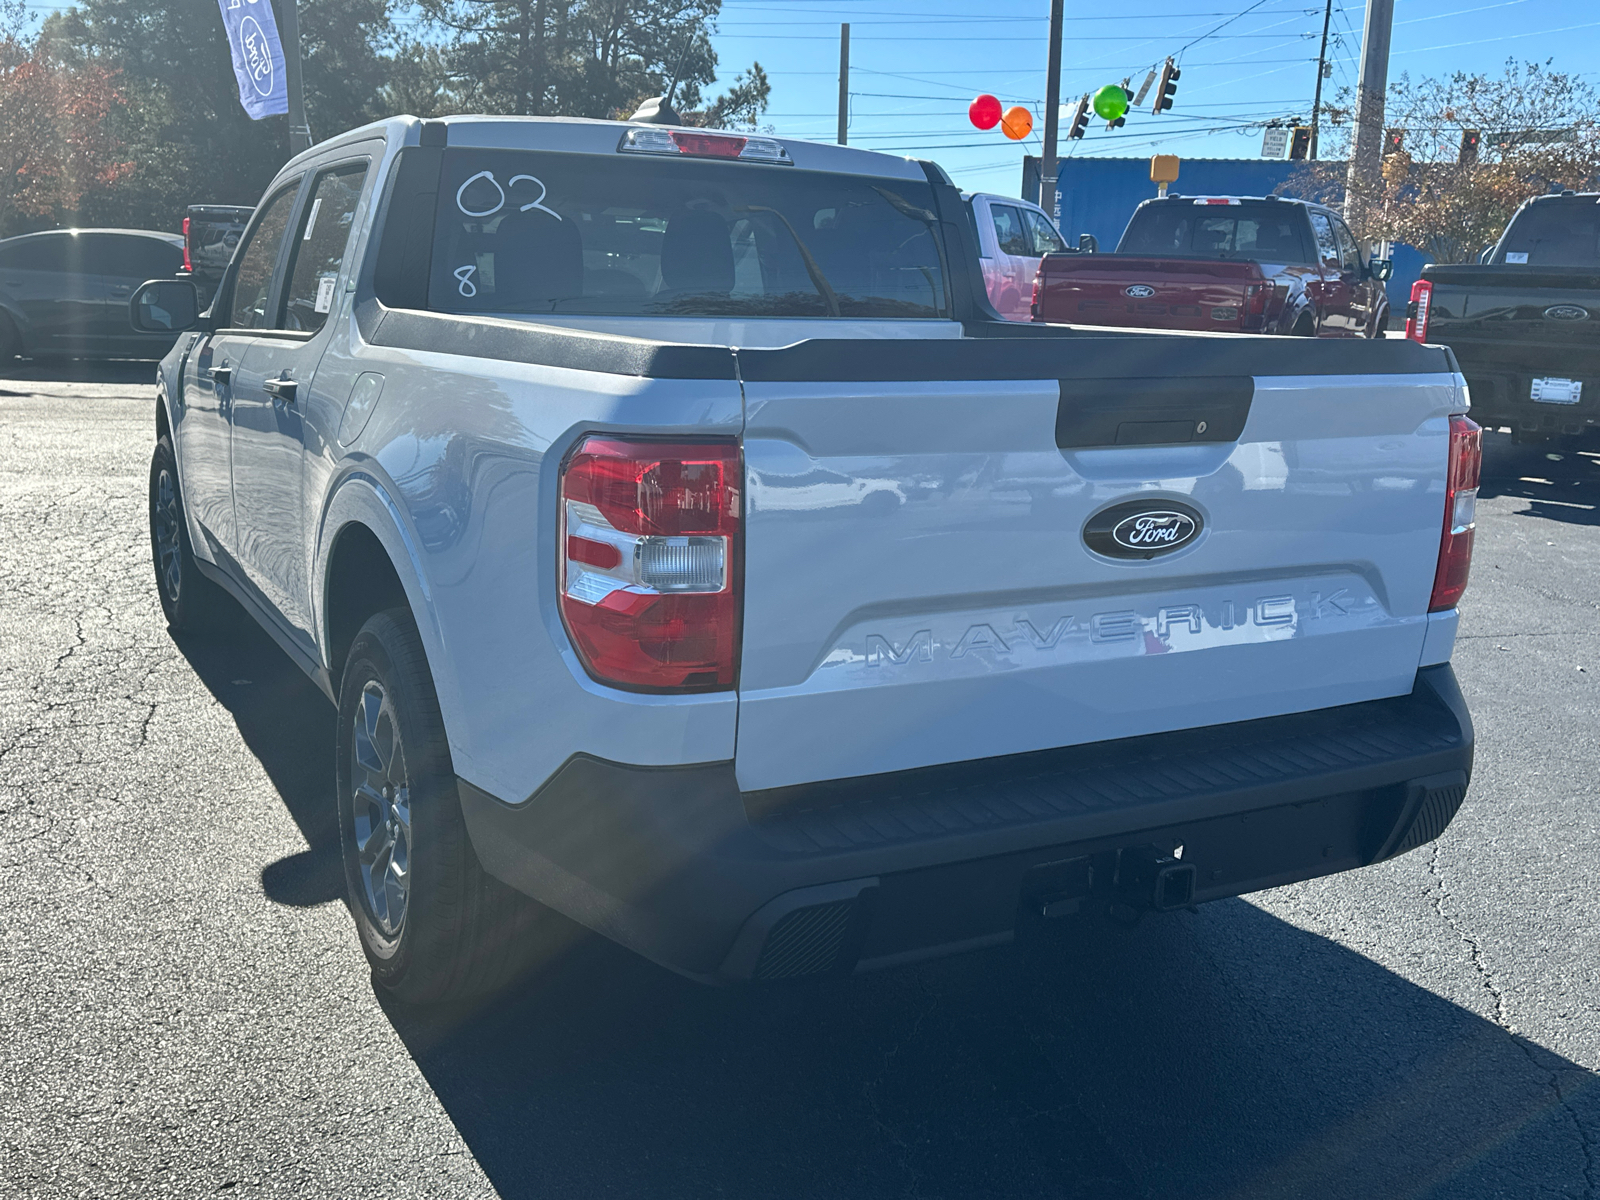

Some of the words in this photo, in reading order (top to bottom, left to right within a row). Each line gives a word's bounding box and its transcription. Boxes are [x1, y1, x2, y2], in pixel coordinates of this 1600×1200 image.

[456, 170, 563, 222] 02
[453, 264, 477, 298] 8
[1129, 287, 1150, 298] Ford
[1077, 301, 1203, 318] F-150
[1554, 308, 1578, 319] Ford
[1129, 517, 1181, 544] Ford
[865, 587, 1352, 668] MAVERICK
